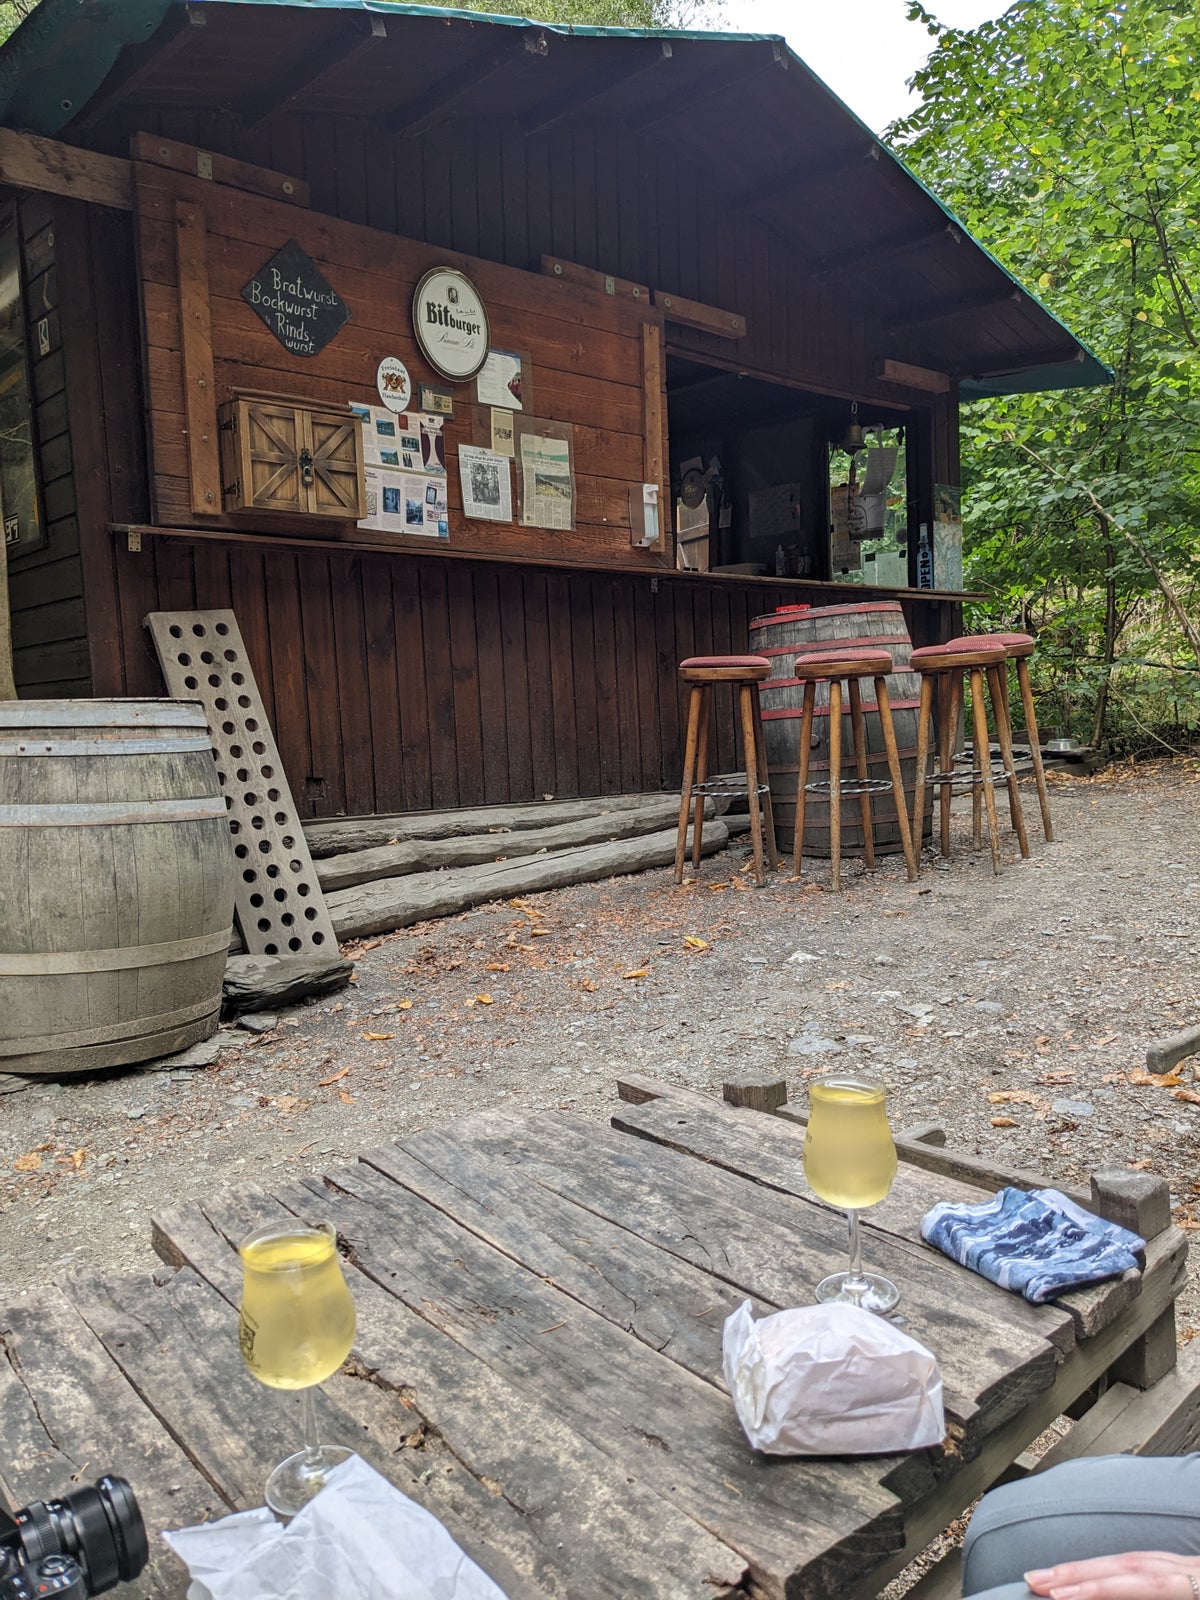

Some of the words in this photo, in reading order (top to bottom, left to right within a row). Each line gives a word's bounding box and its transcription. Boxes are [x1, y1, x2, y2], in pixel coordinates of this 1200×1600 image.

[250, 280, 318, 320] Bockwurst
[271, 268, 338, 305] Bratwurst
[425, 300, 481, 336] Bitburger
[285, 339, 315, 353] wurst
